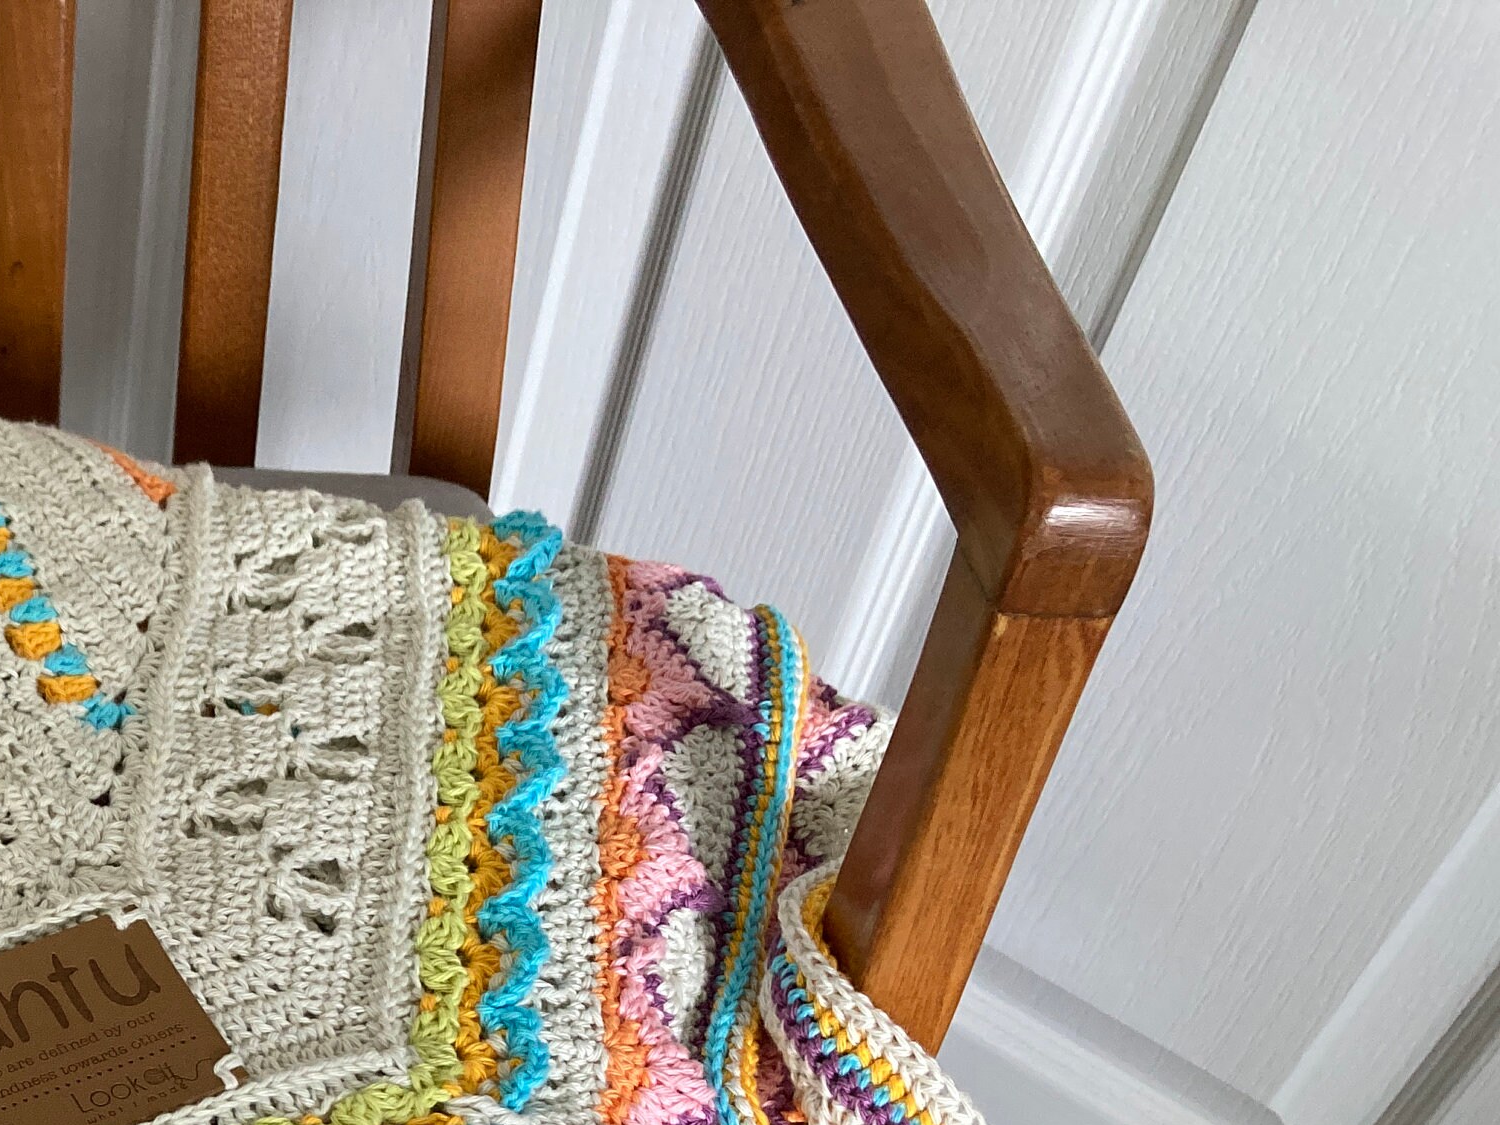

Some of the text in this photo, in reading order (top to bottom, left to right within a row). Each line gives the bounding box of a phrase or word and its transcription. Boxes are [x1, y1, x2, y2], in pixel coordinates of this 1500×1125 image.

[7, 1057, 35, 1074] are
[38, 1032, 100, 1061] defined
[100, 1024, 122, 1039] by
[127, 1011, 156, 1029] our
[60, 1046, 128, 1076] towards
[131, 1022, 189, 1049] others.
